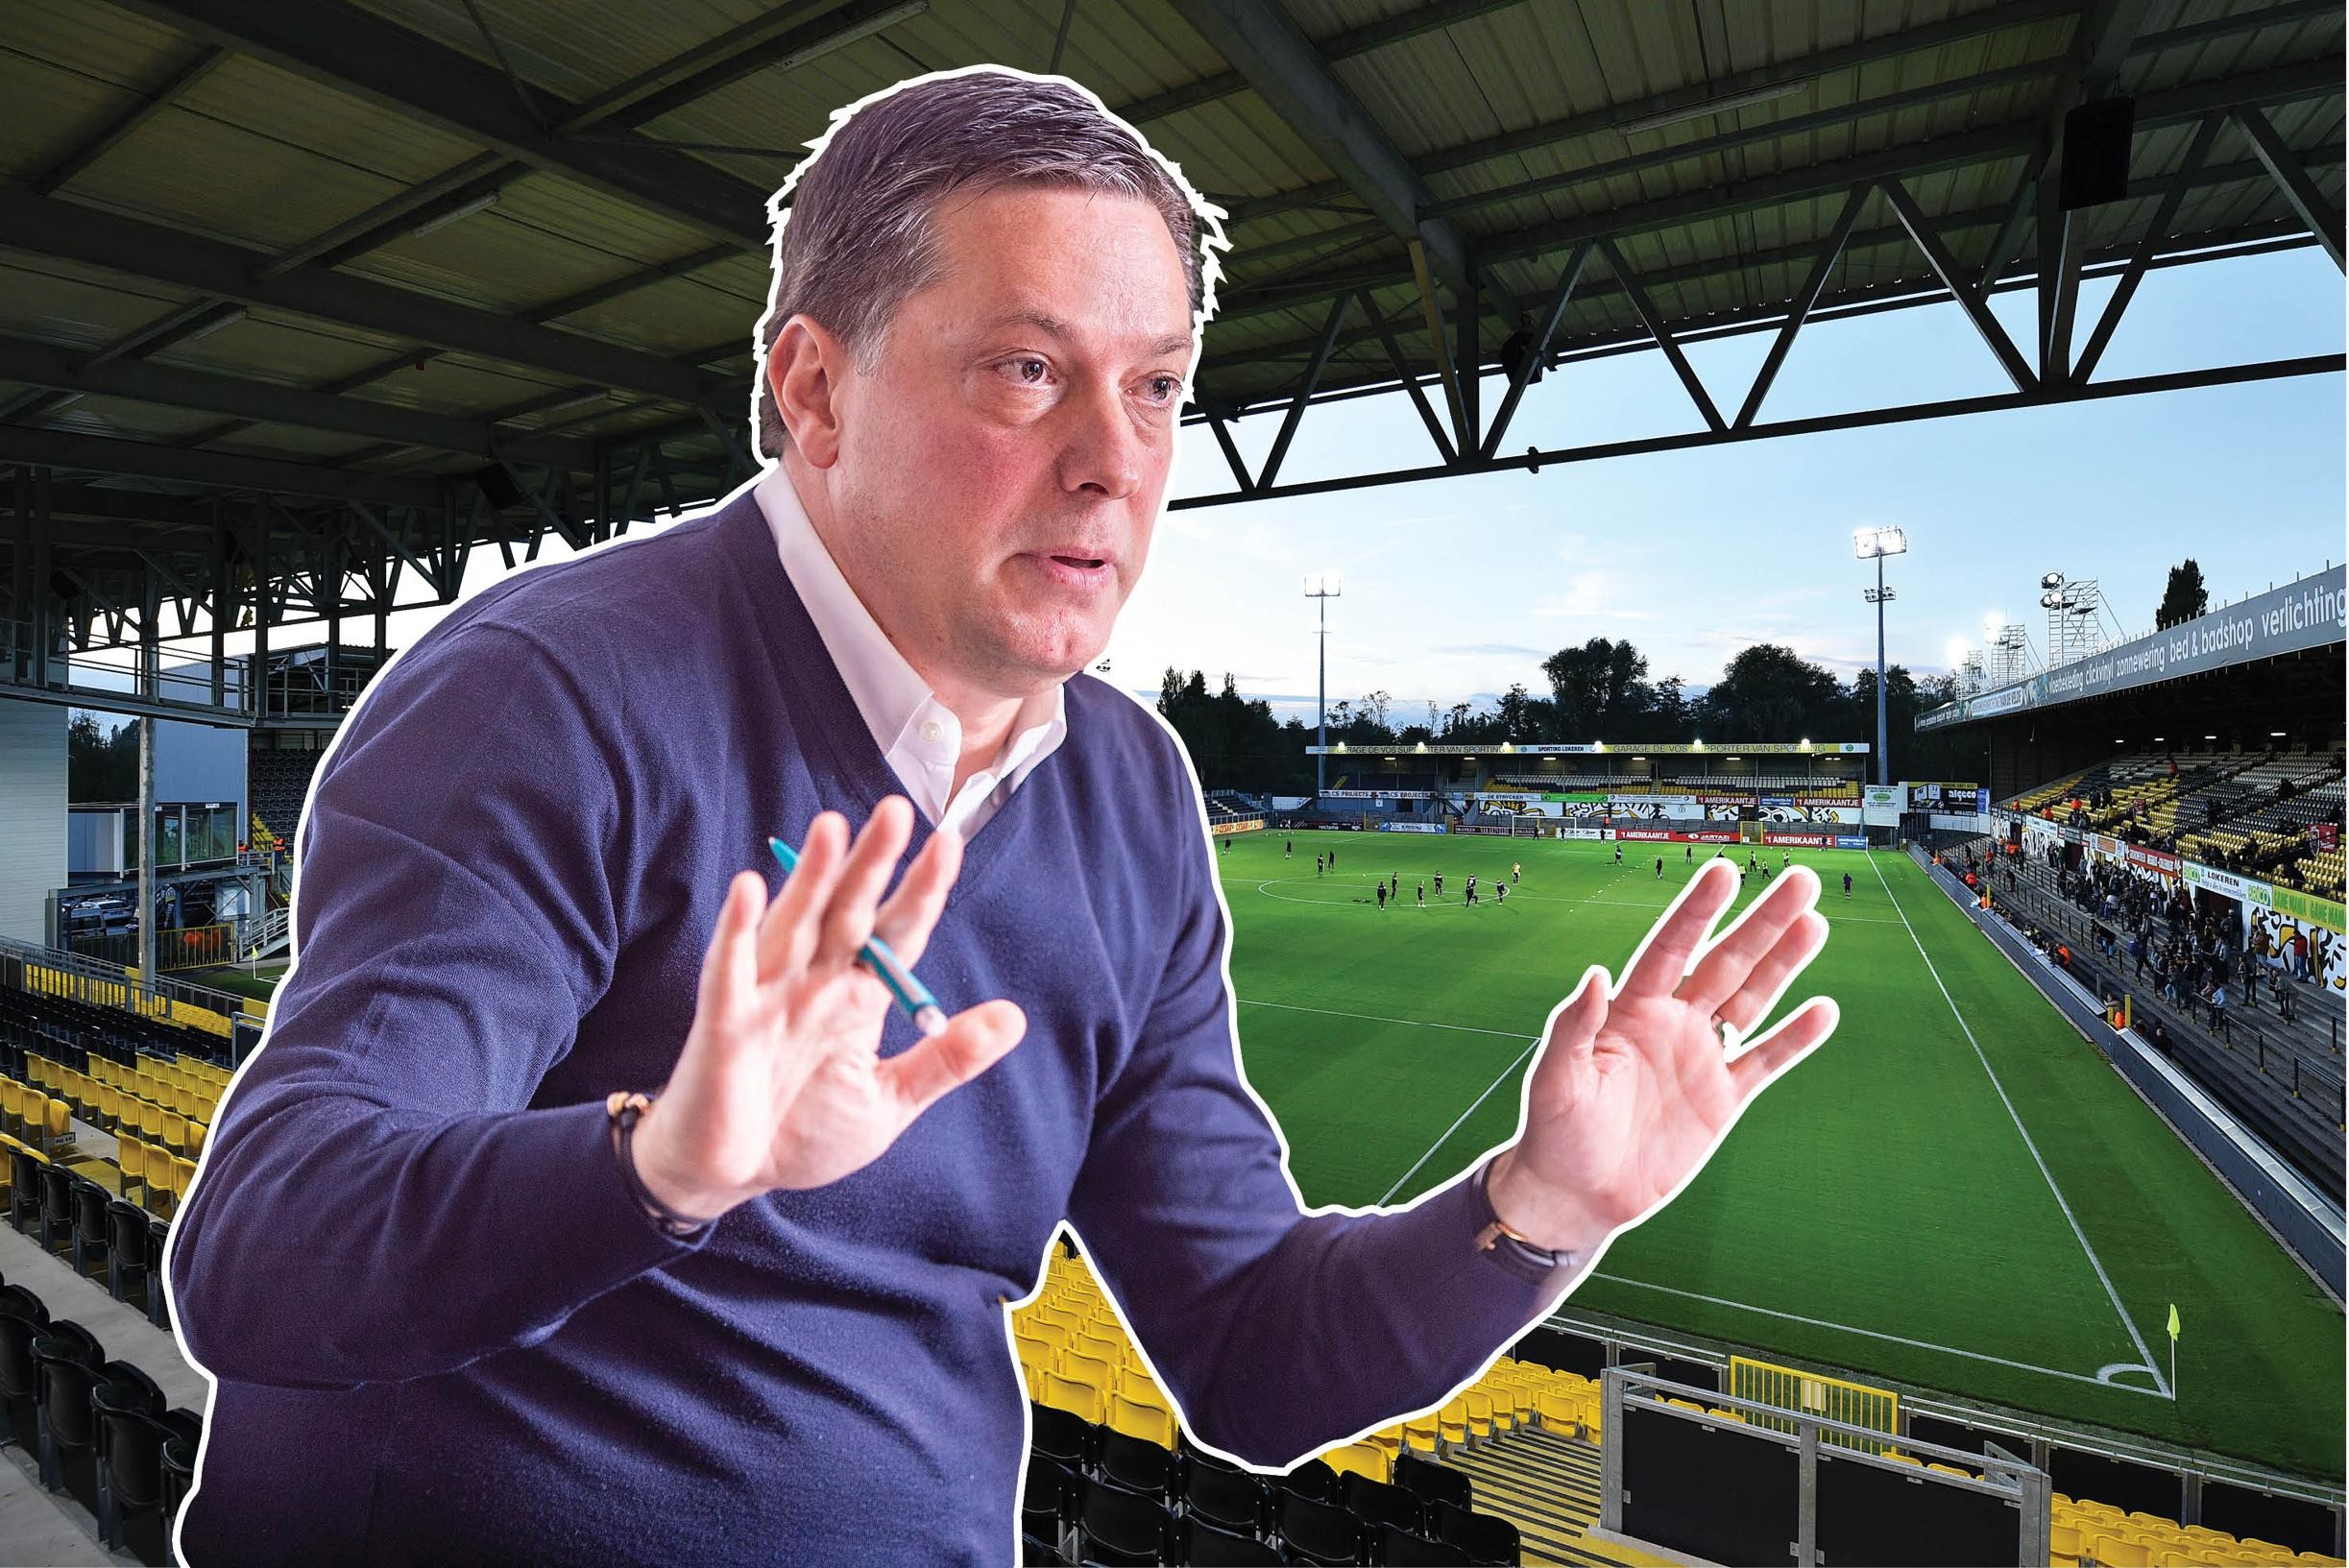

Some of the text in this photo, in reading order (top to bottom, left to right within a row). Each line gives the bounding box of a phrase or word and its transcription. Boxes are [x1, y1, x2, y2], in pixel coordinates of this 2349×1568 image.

[2117, 643, 2166, 677] zonnewering
[2169, 631, 2189, 663] bed
[2192, 630, 2198, 658] &
[2201, 615, 2254, 655] badshop
[2261, 585, 2346, 638] verlichting
[1368, 745, 1380, 754] DE
[1382, 745, 1396, 754] VOS
[1612, 744, 1650, 753] GARAGE
[1653, 744, 1666, 753] DE
[1669, 744, 1688, 753] VOS
[1753, 744, 1771, 753] VAN
[1773, 744, 1825, 753] SPORNG
[1626, 831, 1669, 840] AMERIKAANTJE
[1773, 835, 1832, 845] AMERIKAANTE
[2208, 871, 2240, 887] LOKEREN
[2248, 884, 2269, 905] BRICO
